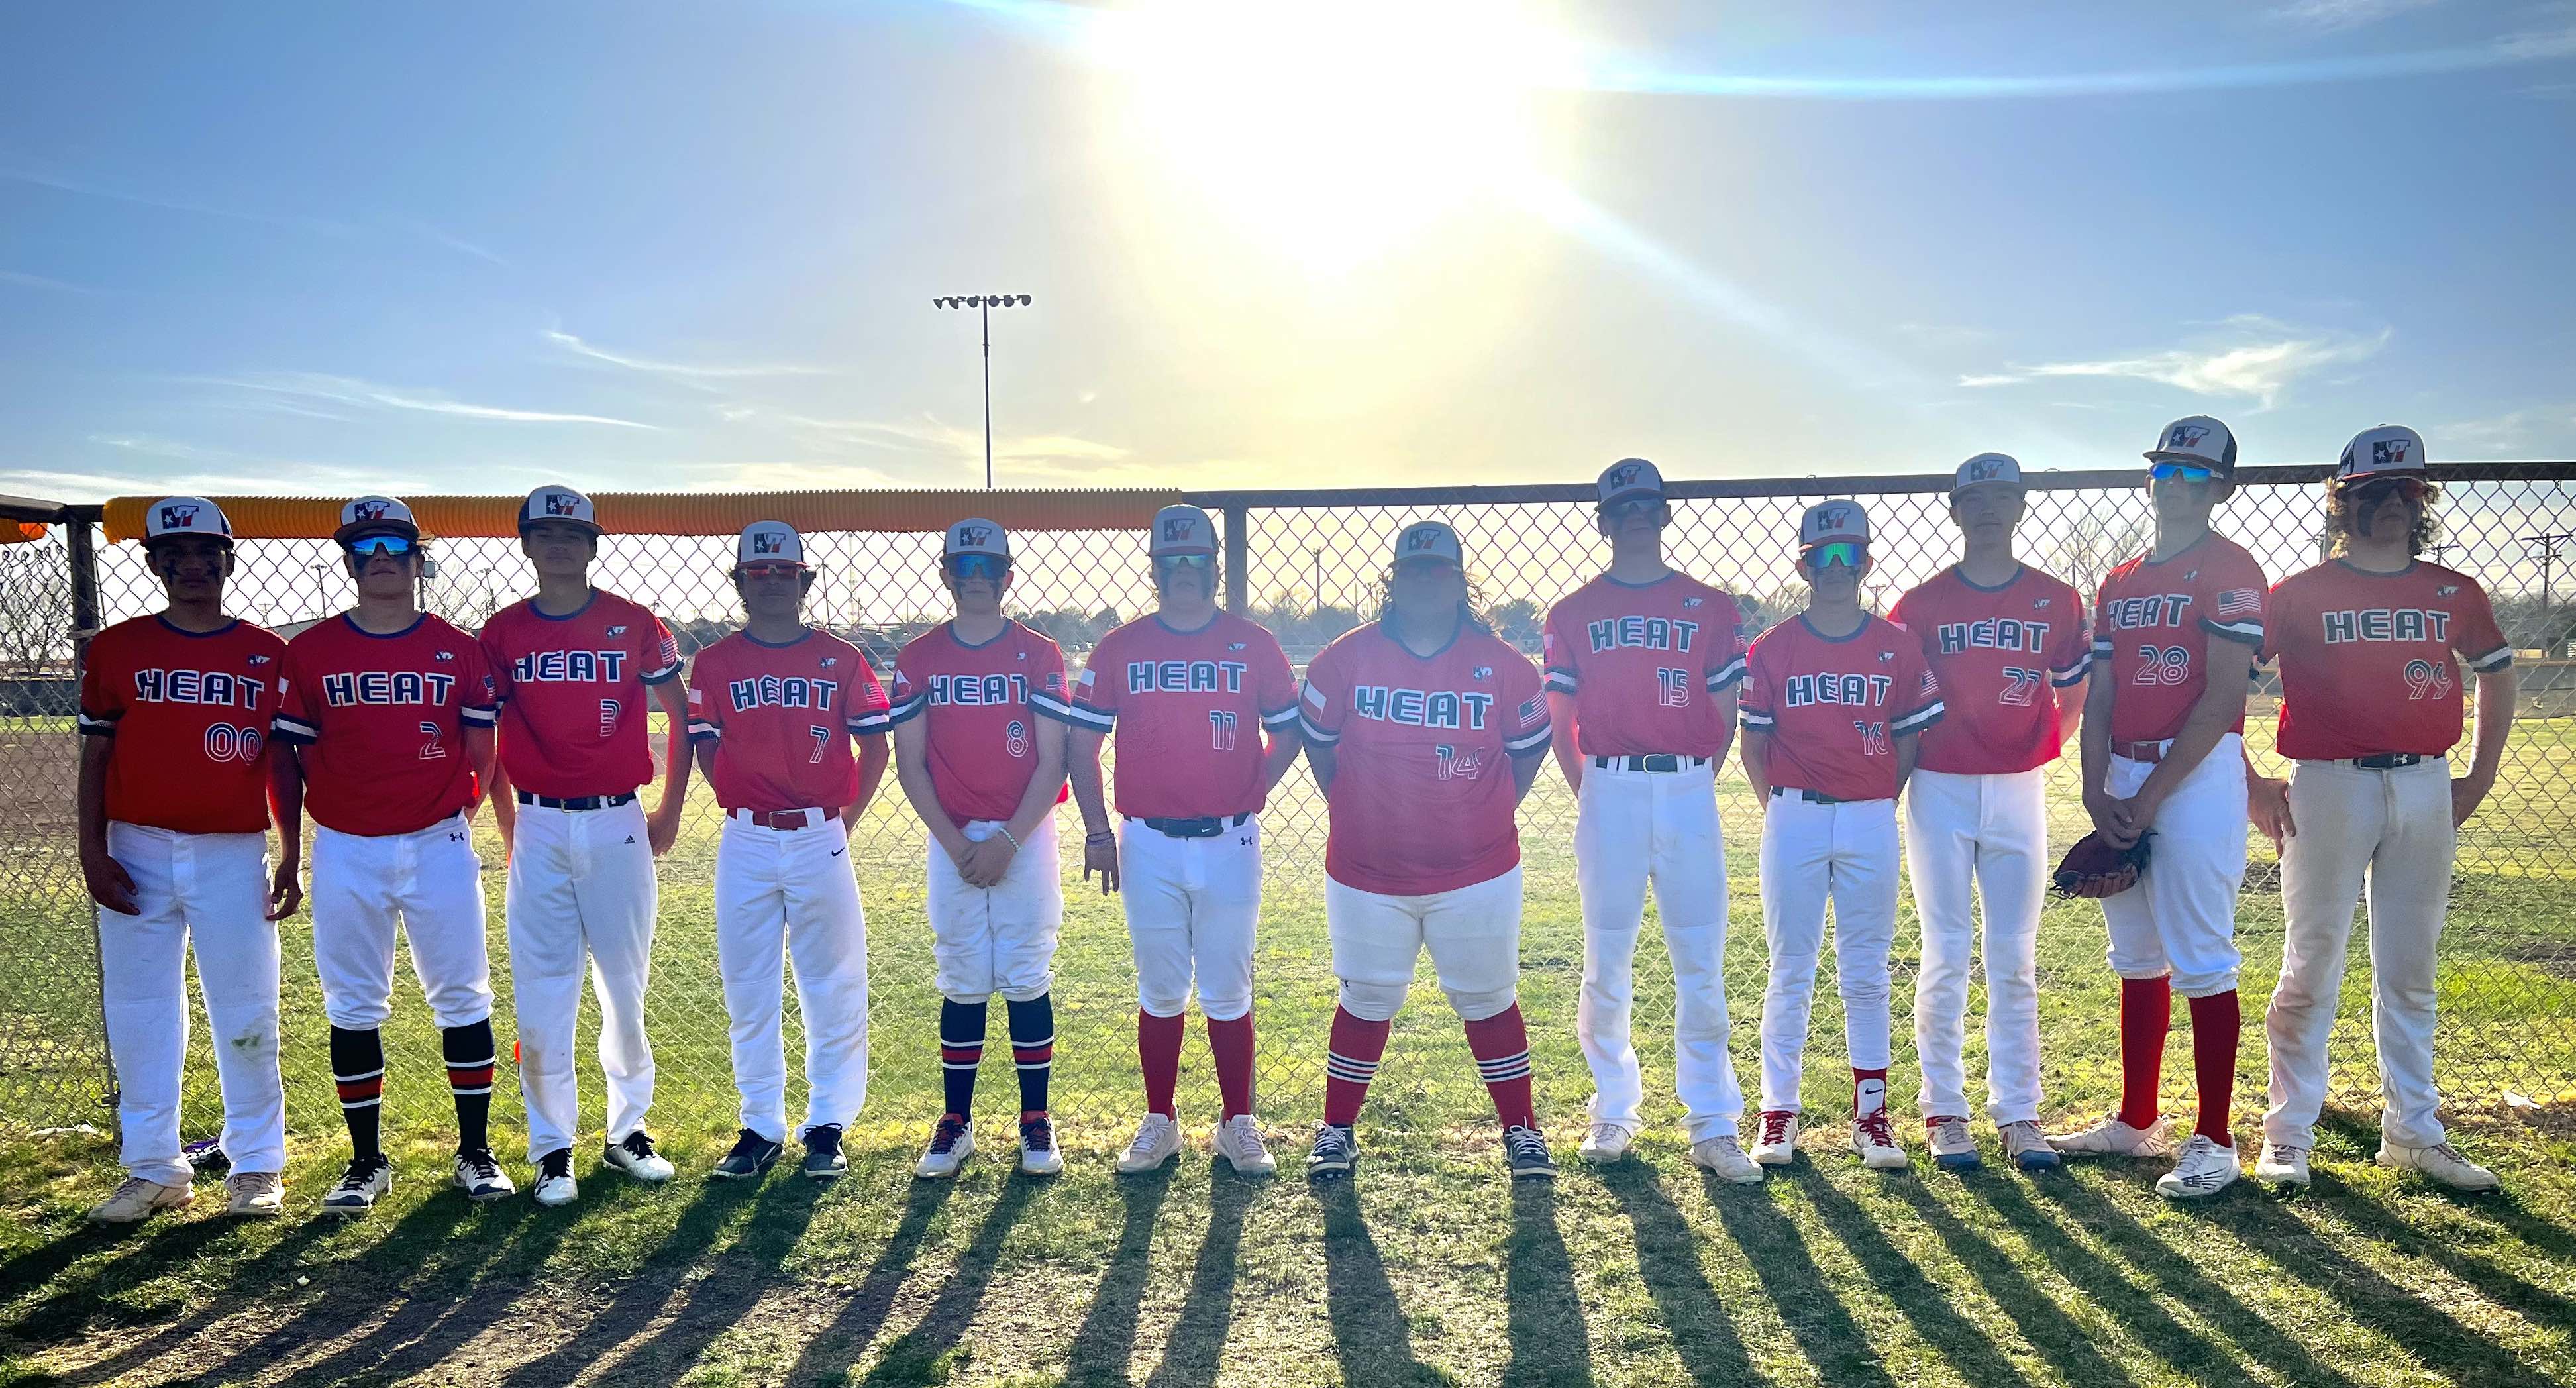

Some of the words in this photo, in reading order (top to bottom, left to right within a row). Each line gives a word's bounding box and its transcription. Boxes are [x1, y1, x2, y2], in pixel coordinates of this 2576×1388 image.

[2107, 594, 2192, 631] HEAT
[2322, 609, 2450, 644] HEAT
[1587, 616, 1698, 654] HEAT
[1937, 617, 2049, 654] HEAT
[1127, 661, 1247, 694] HEAT
[2133, 645, 2189, 685] 28
[135, 668, 264, 711] HEAT
[323, 672, 455, 706] HEAT
[730, 675, 837, 712] HEAT
[928, 674, 1028, 706] HEAT
[1657, 667, 1690, 707] 15
[1786, 672, 1892, 707] HEAT
[1999, 666, 2042, 706] 27
[600, 699, 621, 737] 3
[1355, 686, 1493, 729] HEAT
[418, 721, 446, 760] 2
[809, 726, 831, 763] 7
[1007, 720, 1028, 757] 8
[1210, 711, 1237, 751] 11
